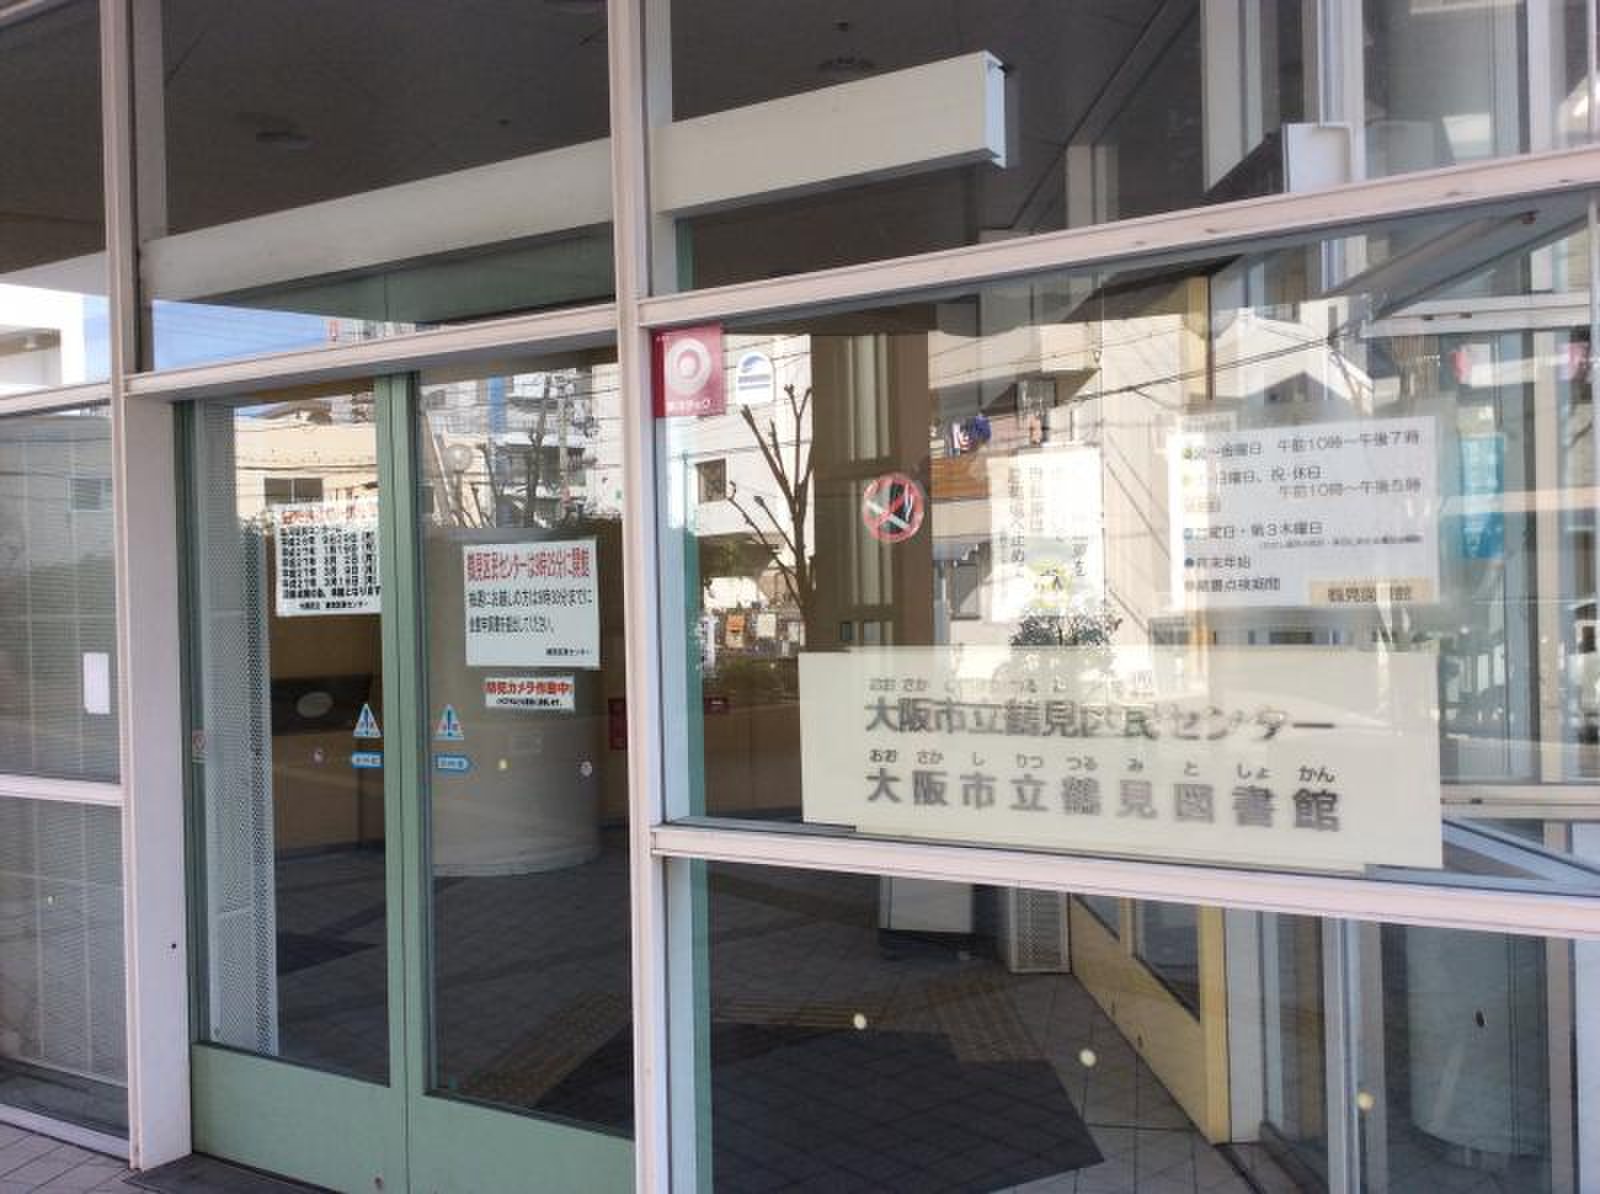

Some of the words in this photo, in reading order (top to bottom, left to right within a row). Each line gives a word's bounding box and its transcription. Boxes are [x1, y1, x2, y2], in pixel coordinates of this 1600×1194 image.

[1328, 585, 1413, 603] 鶴見図館
[865, 767, 1341, 832] 大阪市立鶴見図書館
